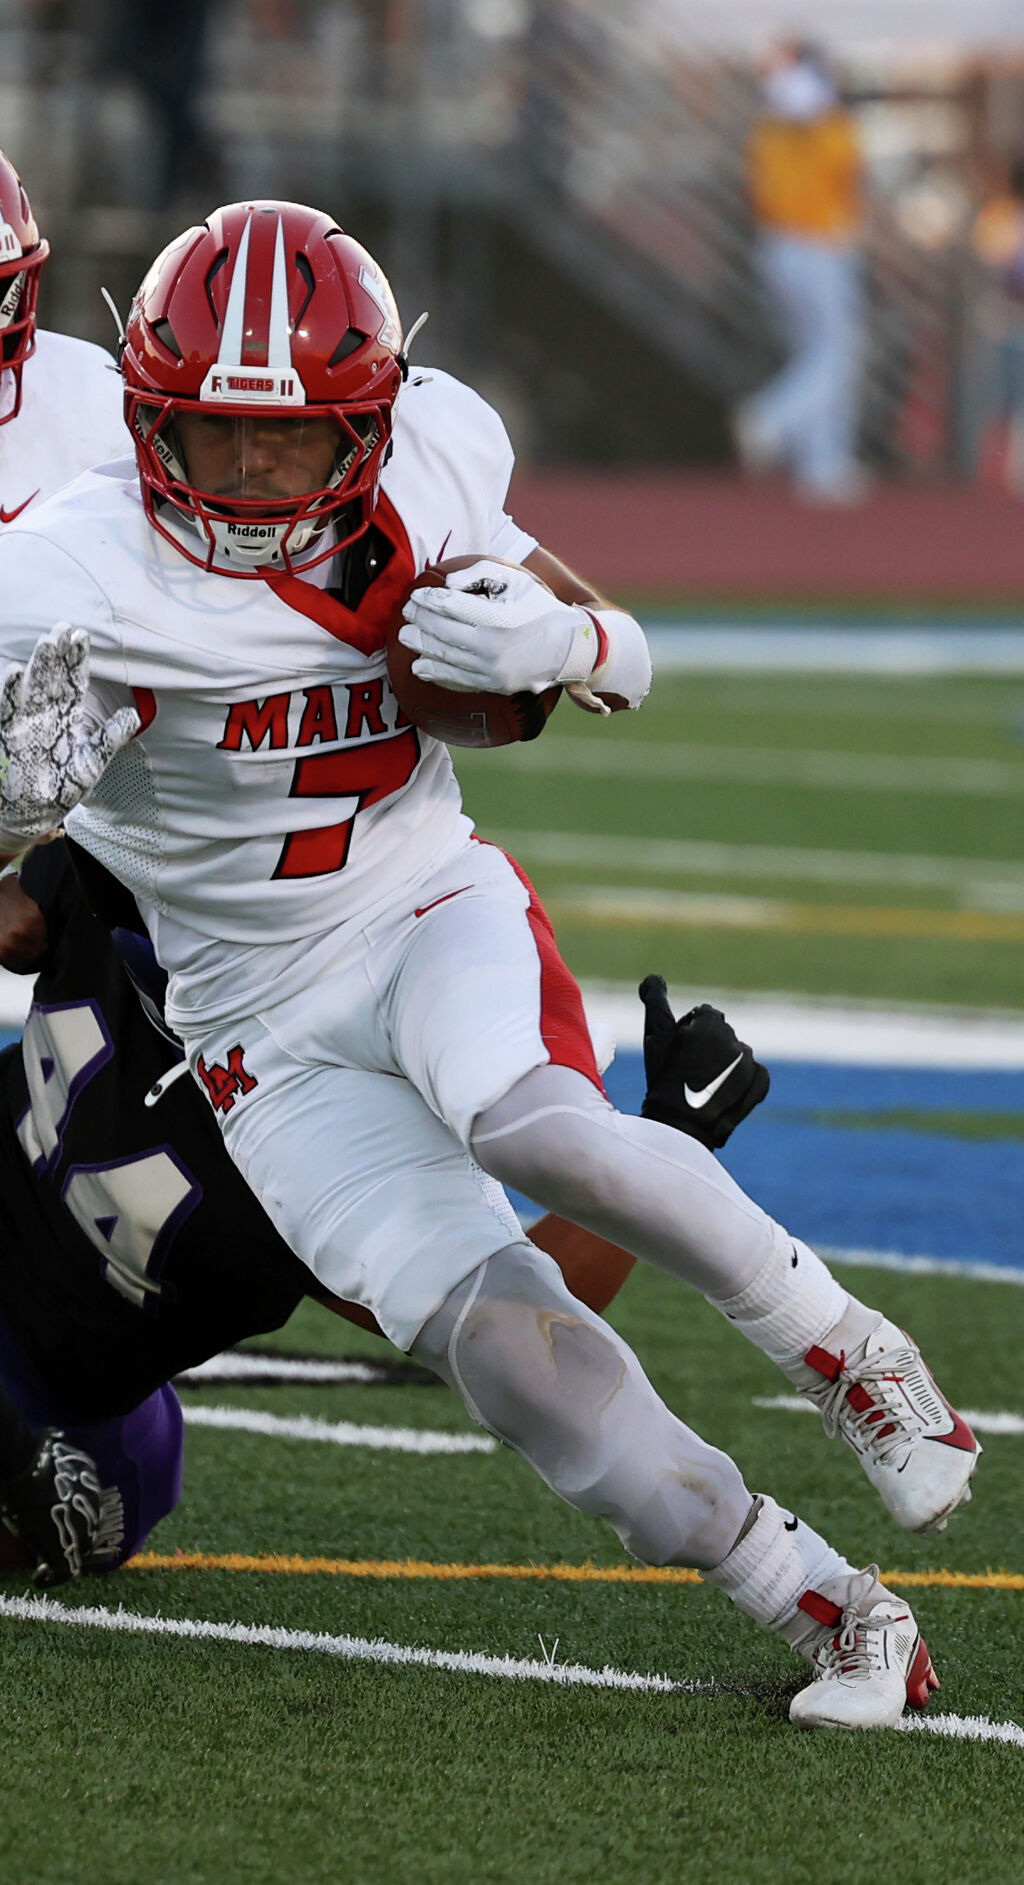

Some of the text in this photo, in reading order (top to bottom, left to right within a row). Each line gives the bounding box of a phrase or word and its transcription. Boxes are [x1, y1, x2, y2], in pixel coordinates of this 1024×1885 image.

[227, 375, 274, 392] TIGERS
[227, 523, 276, 538] Riddell
[216, 677, 416, 752] MAR
[269, 726, 422, 881] 7
